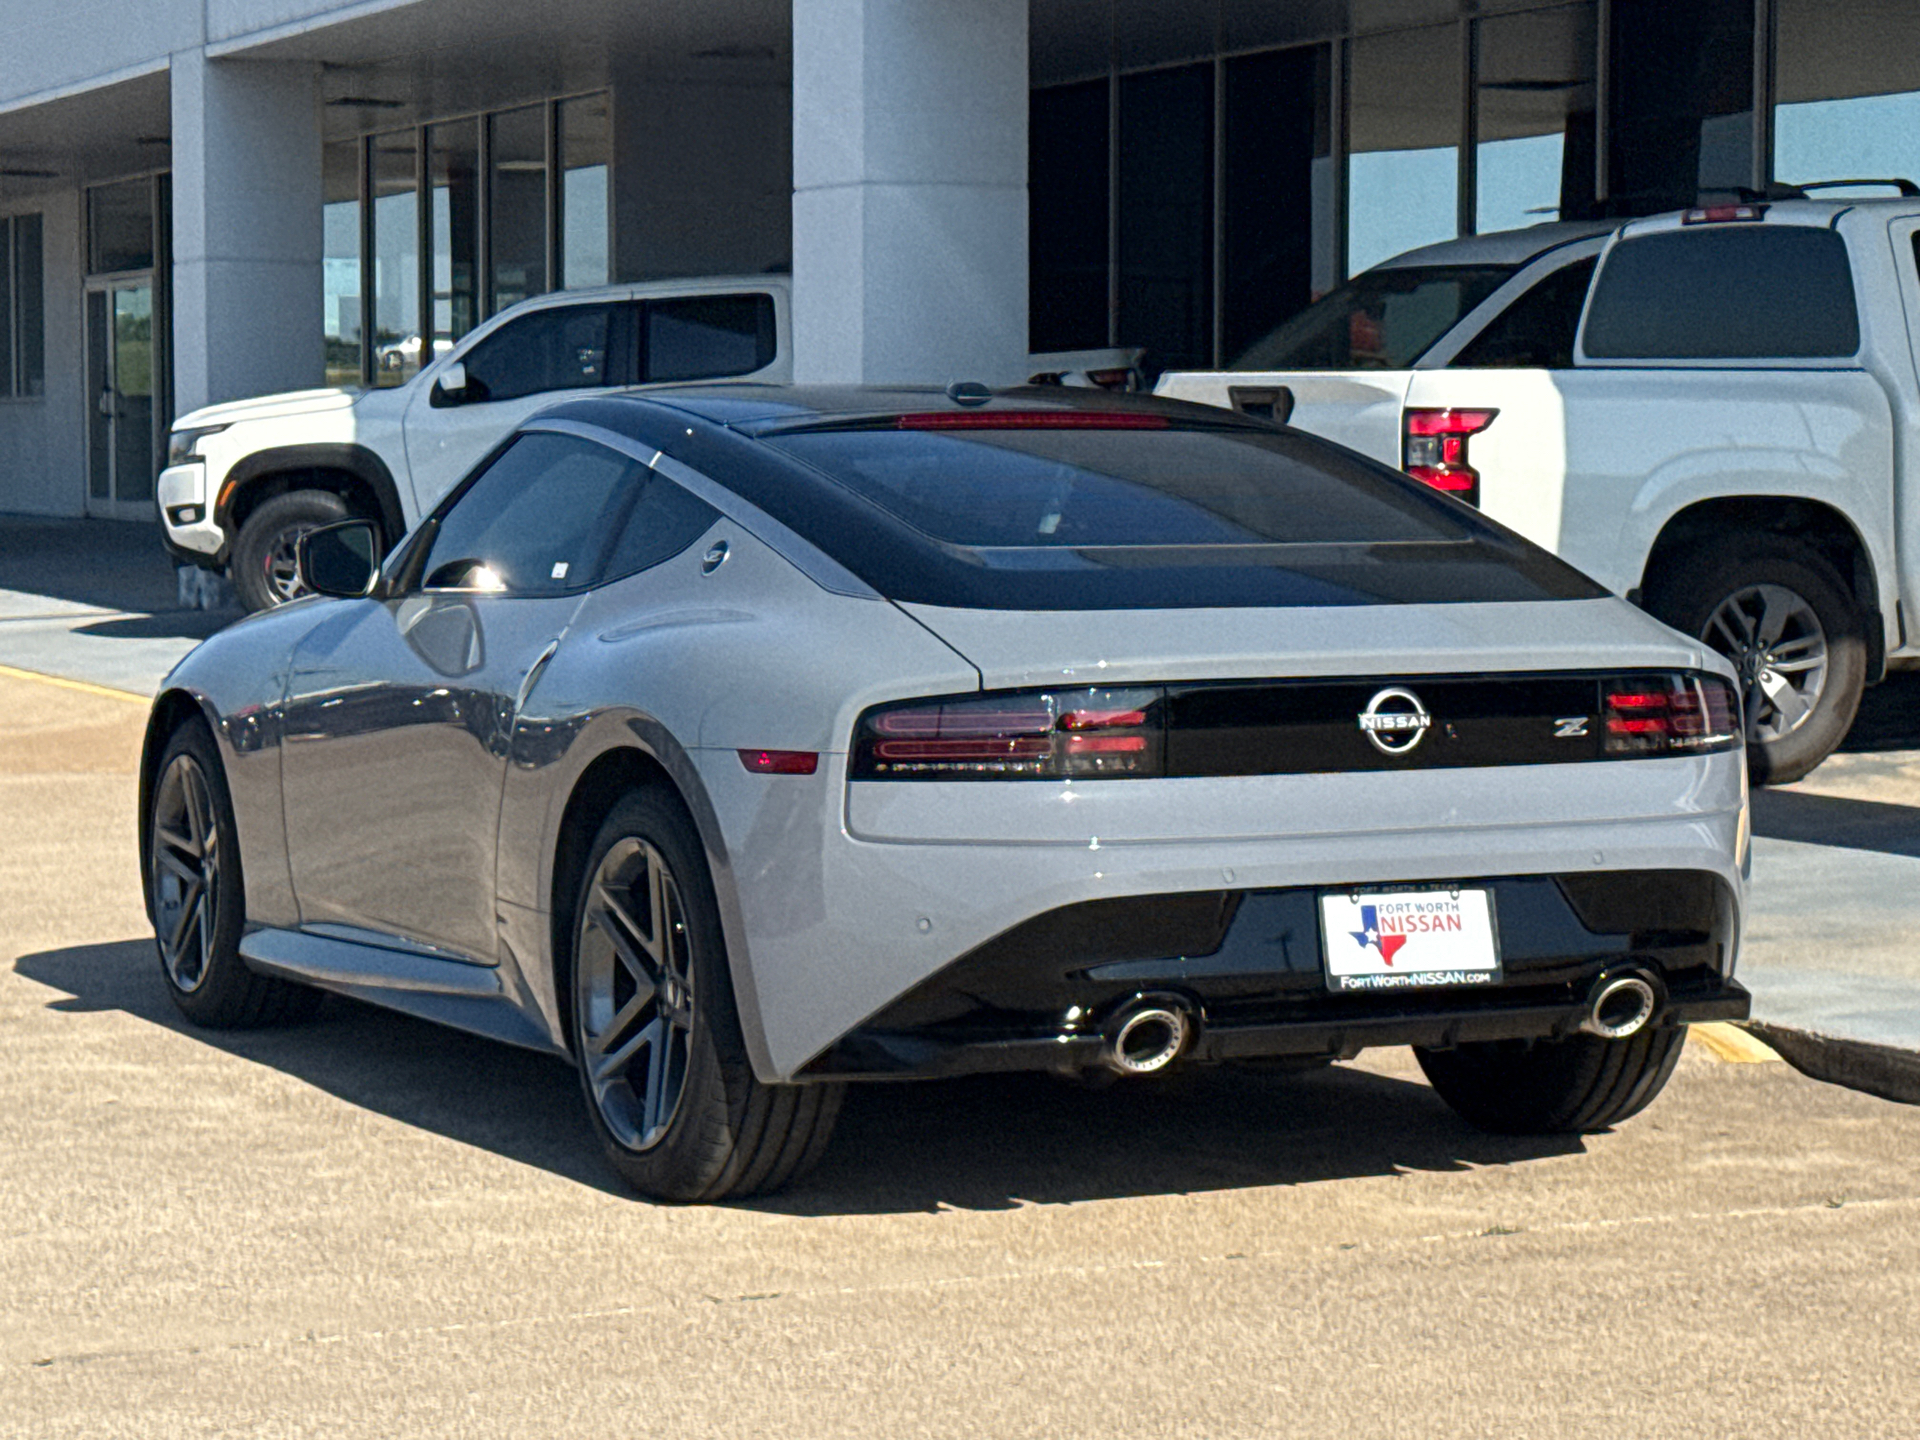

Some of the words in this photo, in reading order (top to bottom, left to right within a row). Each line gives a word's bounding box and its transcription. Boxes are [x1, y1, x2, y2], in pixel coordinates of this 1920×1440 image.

[1359, 714, 1431, 730] NISSAN
[1553, 716, 1589, 738] Z
[1353, 886, 1378, 894] FORT
[1378, 902, 1411, 915] FORT
[1414, 901, 1460, 914] WORTH
[1380, 914, 1462, 933] NISSAN
